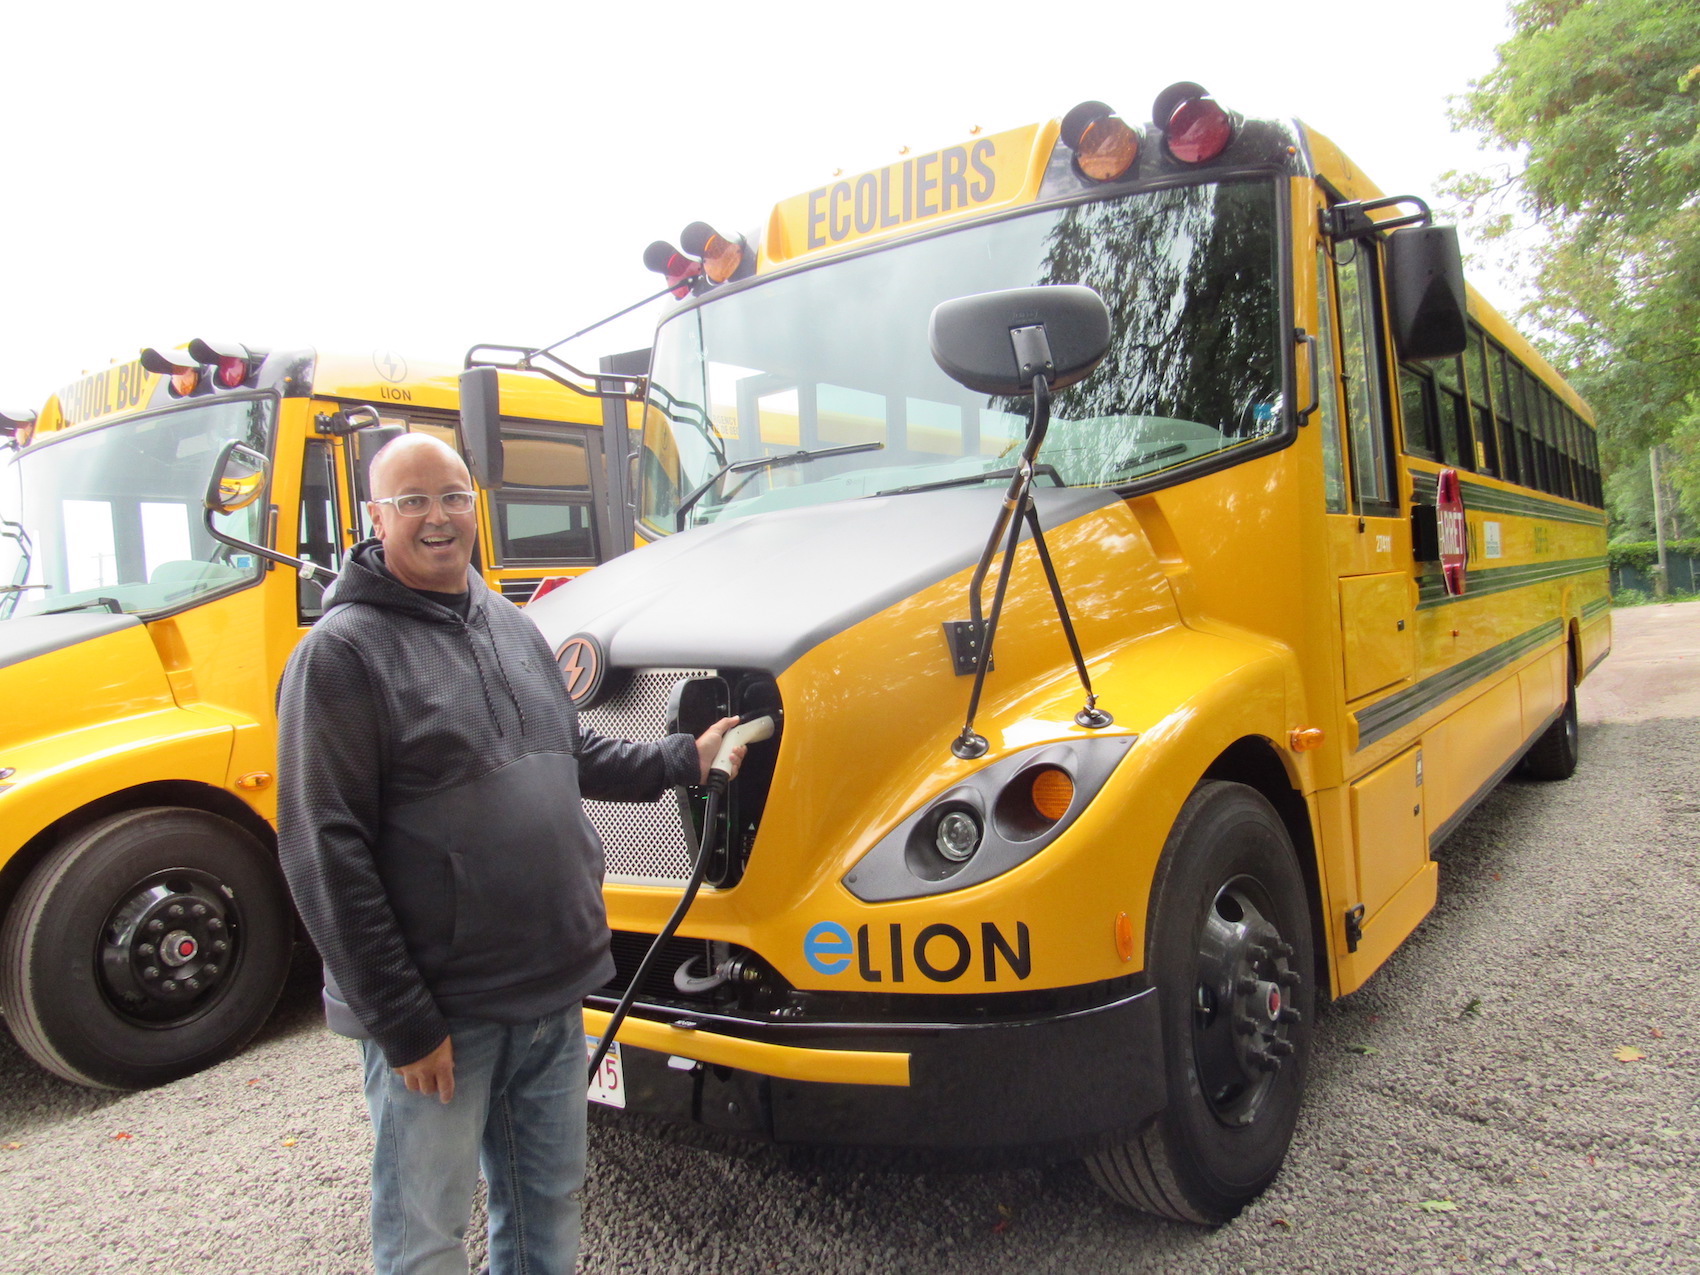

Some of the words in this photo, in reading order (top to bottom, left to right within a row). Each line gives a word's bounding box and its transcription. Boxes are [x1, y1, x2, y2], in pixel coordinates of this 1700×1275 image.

[807, 139, 996, 250] ECOLIERS
[56, 370, 111, 431] SCHOOL
[380, 387, 412, 401] LION
